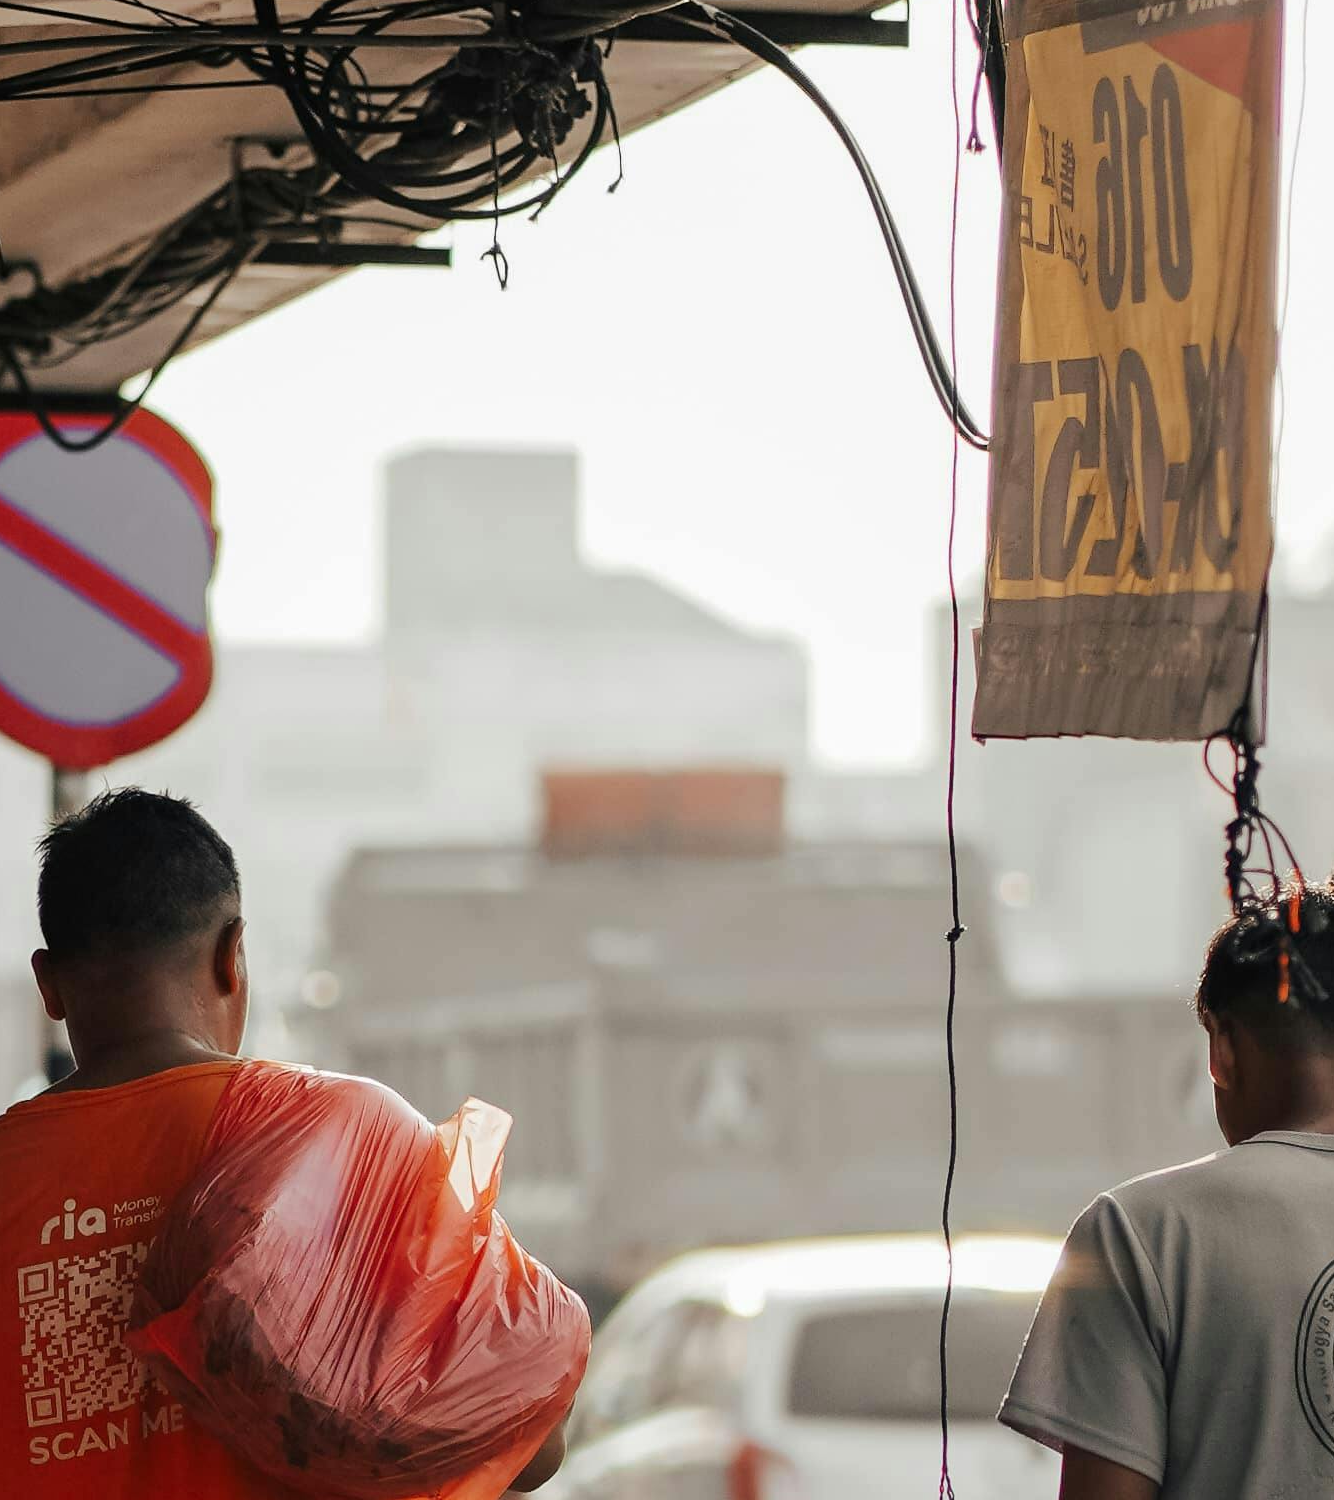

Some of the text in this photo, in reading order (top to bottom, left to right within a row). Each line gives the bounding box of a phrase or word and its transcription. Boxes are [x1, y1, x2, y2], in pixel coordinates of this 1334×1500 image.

[41, 1199, 106, 1244] ria
[113, 1196, 161, 1215] Money
[29, 1403, 184, 1464] SCAN ME
